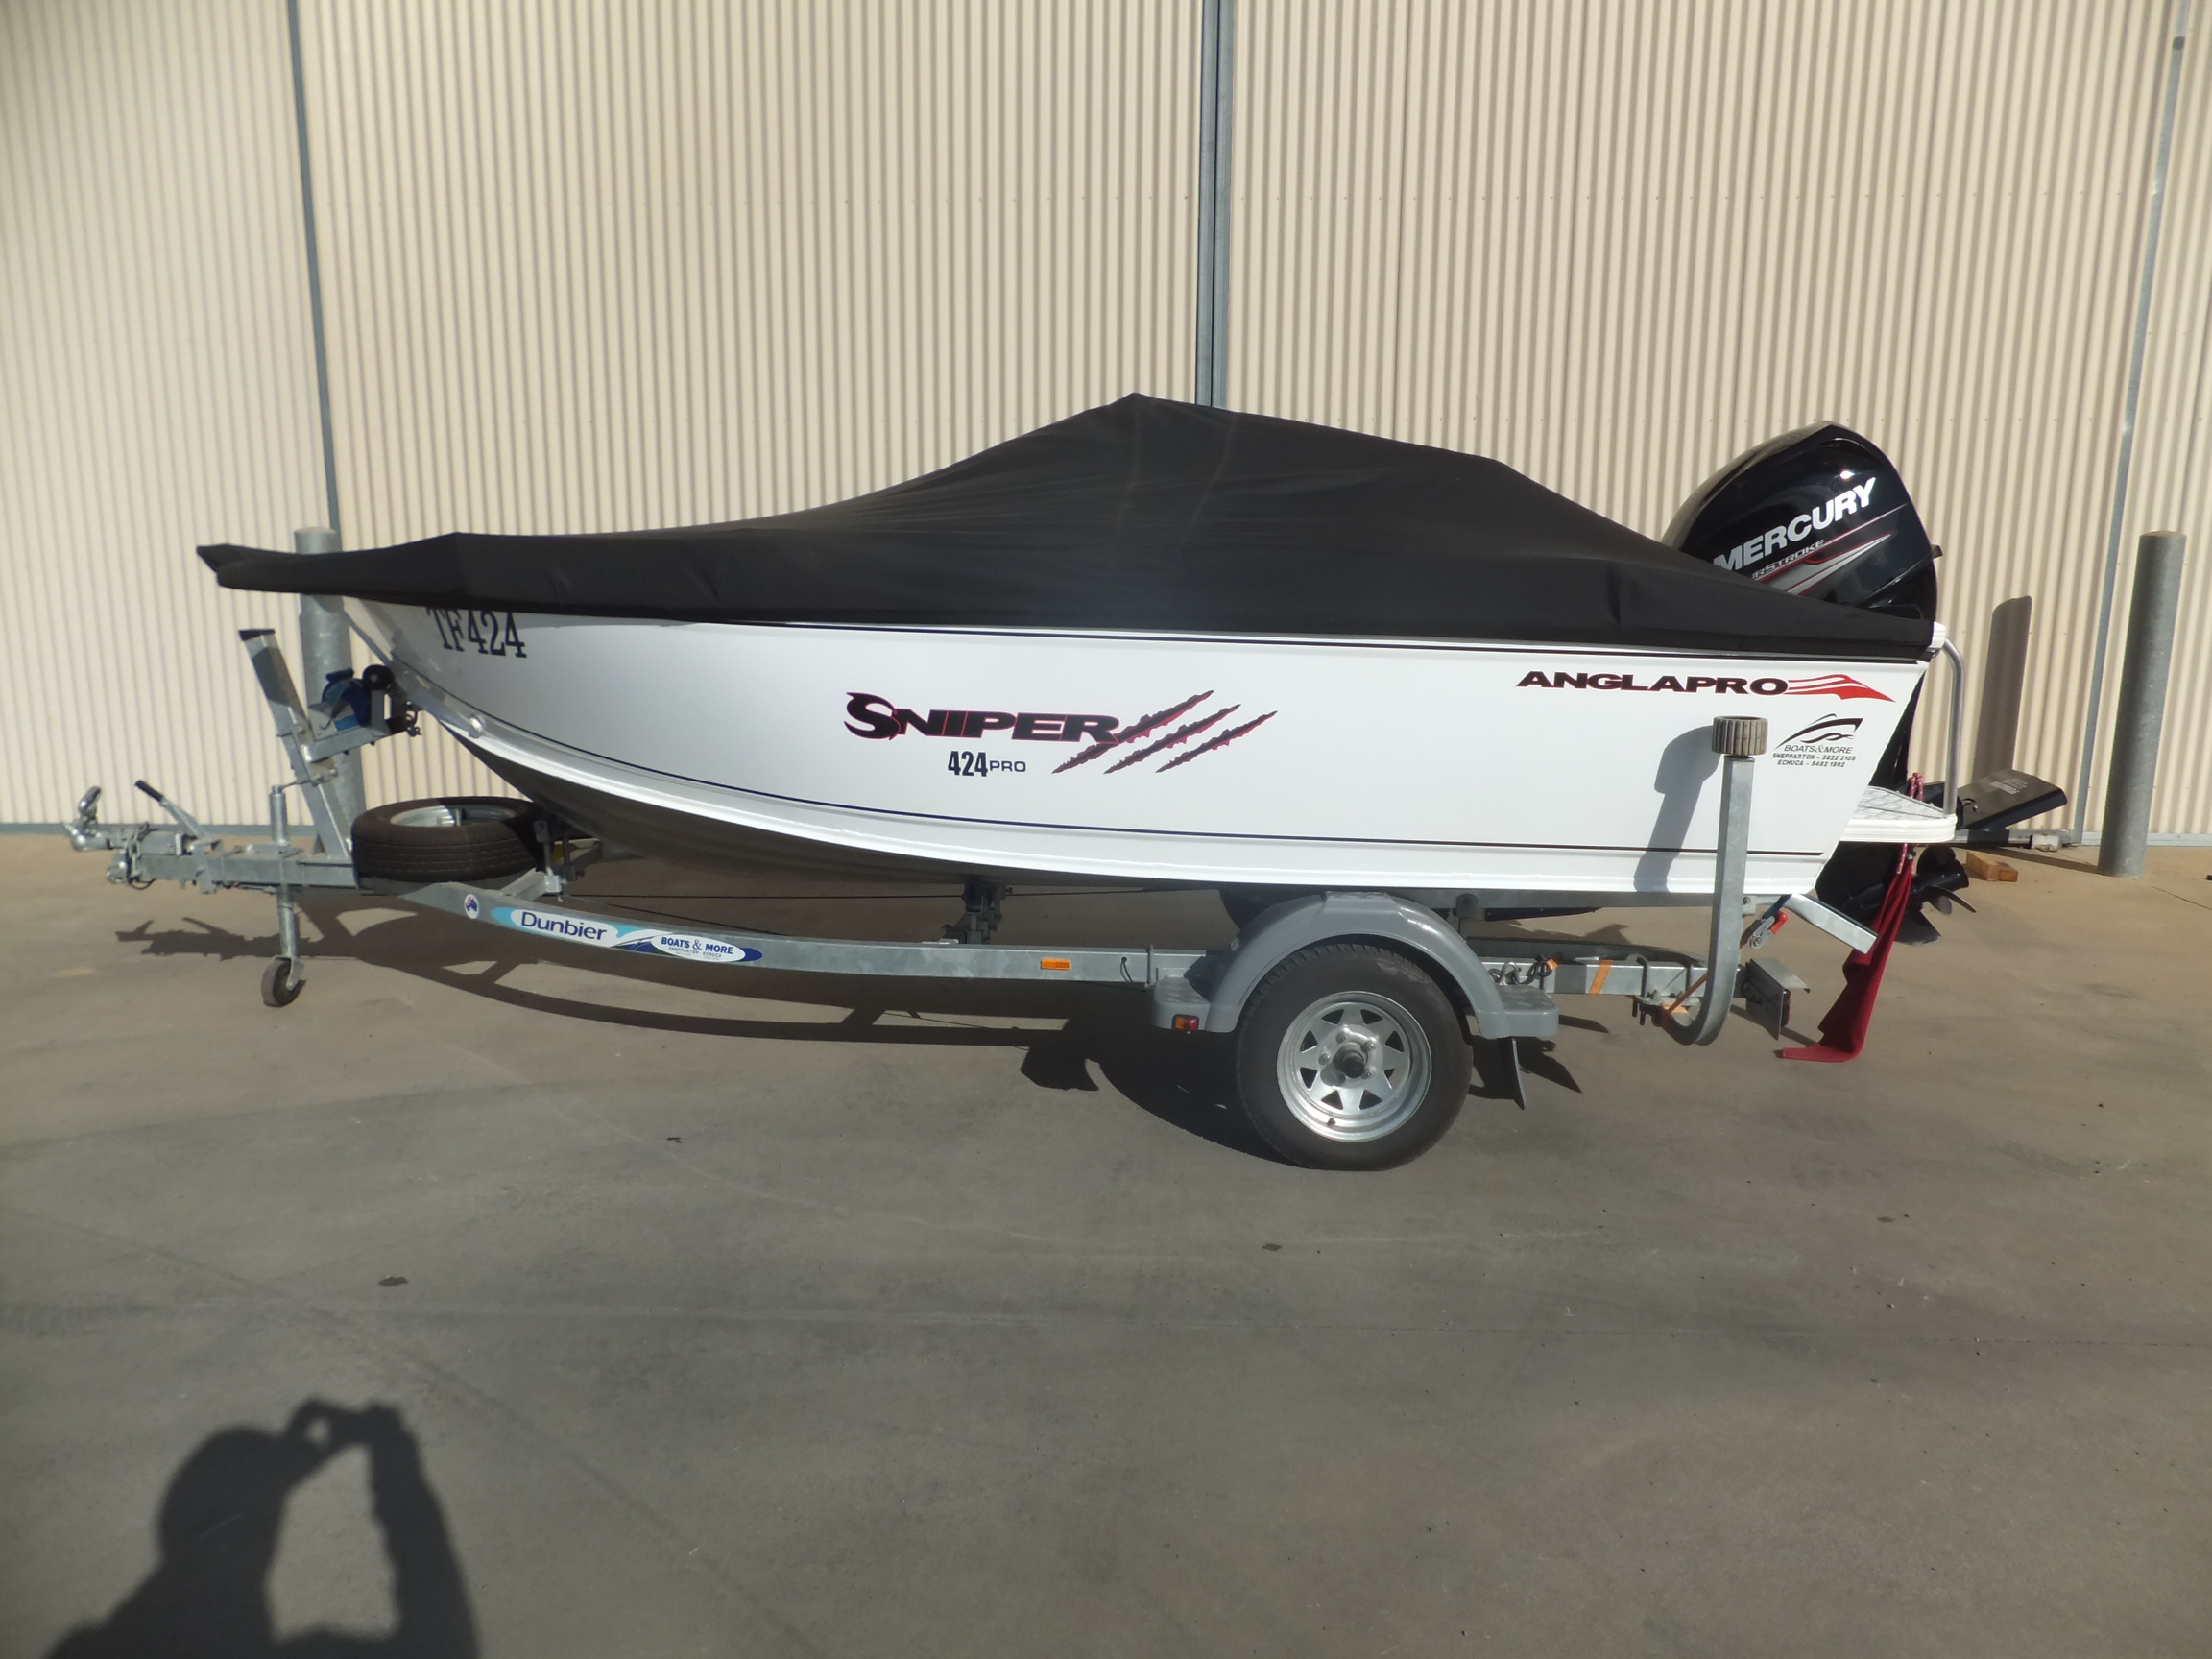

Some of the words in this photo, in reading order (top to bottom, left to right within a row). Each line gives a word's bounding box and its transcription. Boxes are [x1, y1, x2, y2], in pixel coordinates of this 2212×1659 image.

[1713, 476, 1876, 571] MERCURY
[1752, 539, 1825, 580] RSTROKE
[1516, 670, 1789, 696] ANGLAPRO
[844, 692, 1121, 745] SNIPER
[947, 750, 989, 777] 424
[989, 760, 1027, 773] PRO
[520, 911, 607, 941] Dunbier
[661, 937, 690, 949] BOATS
[692, 939, 702, 950] &
[705, 943, 733, 955] MORE
